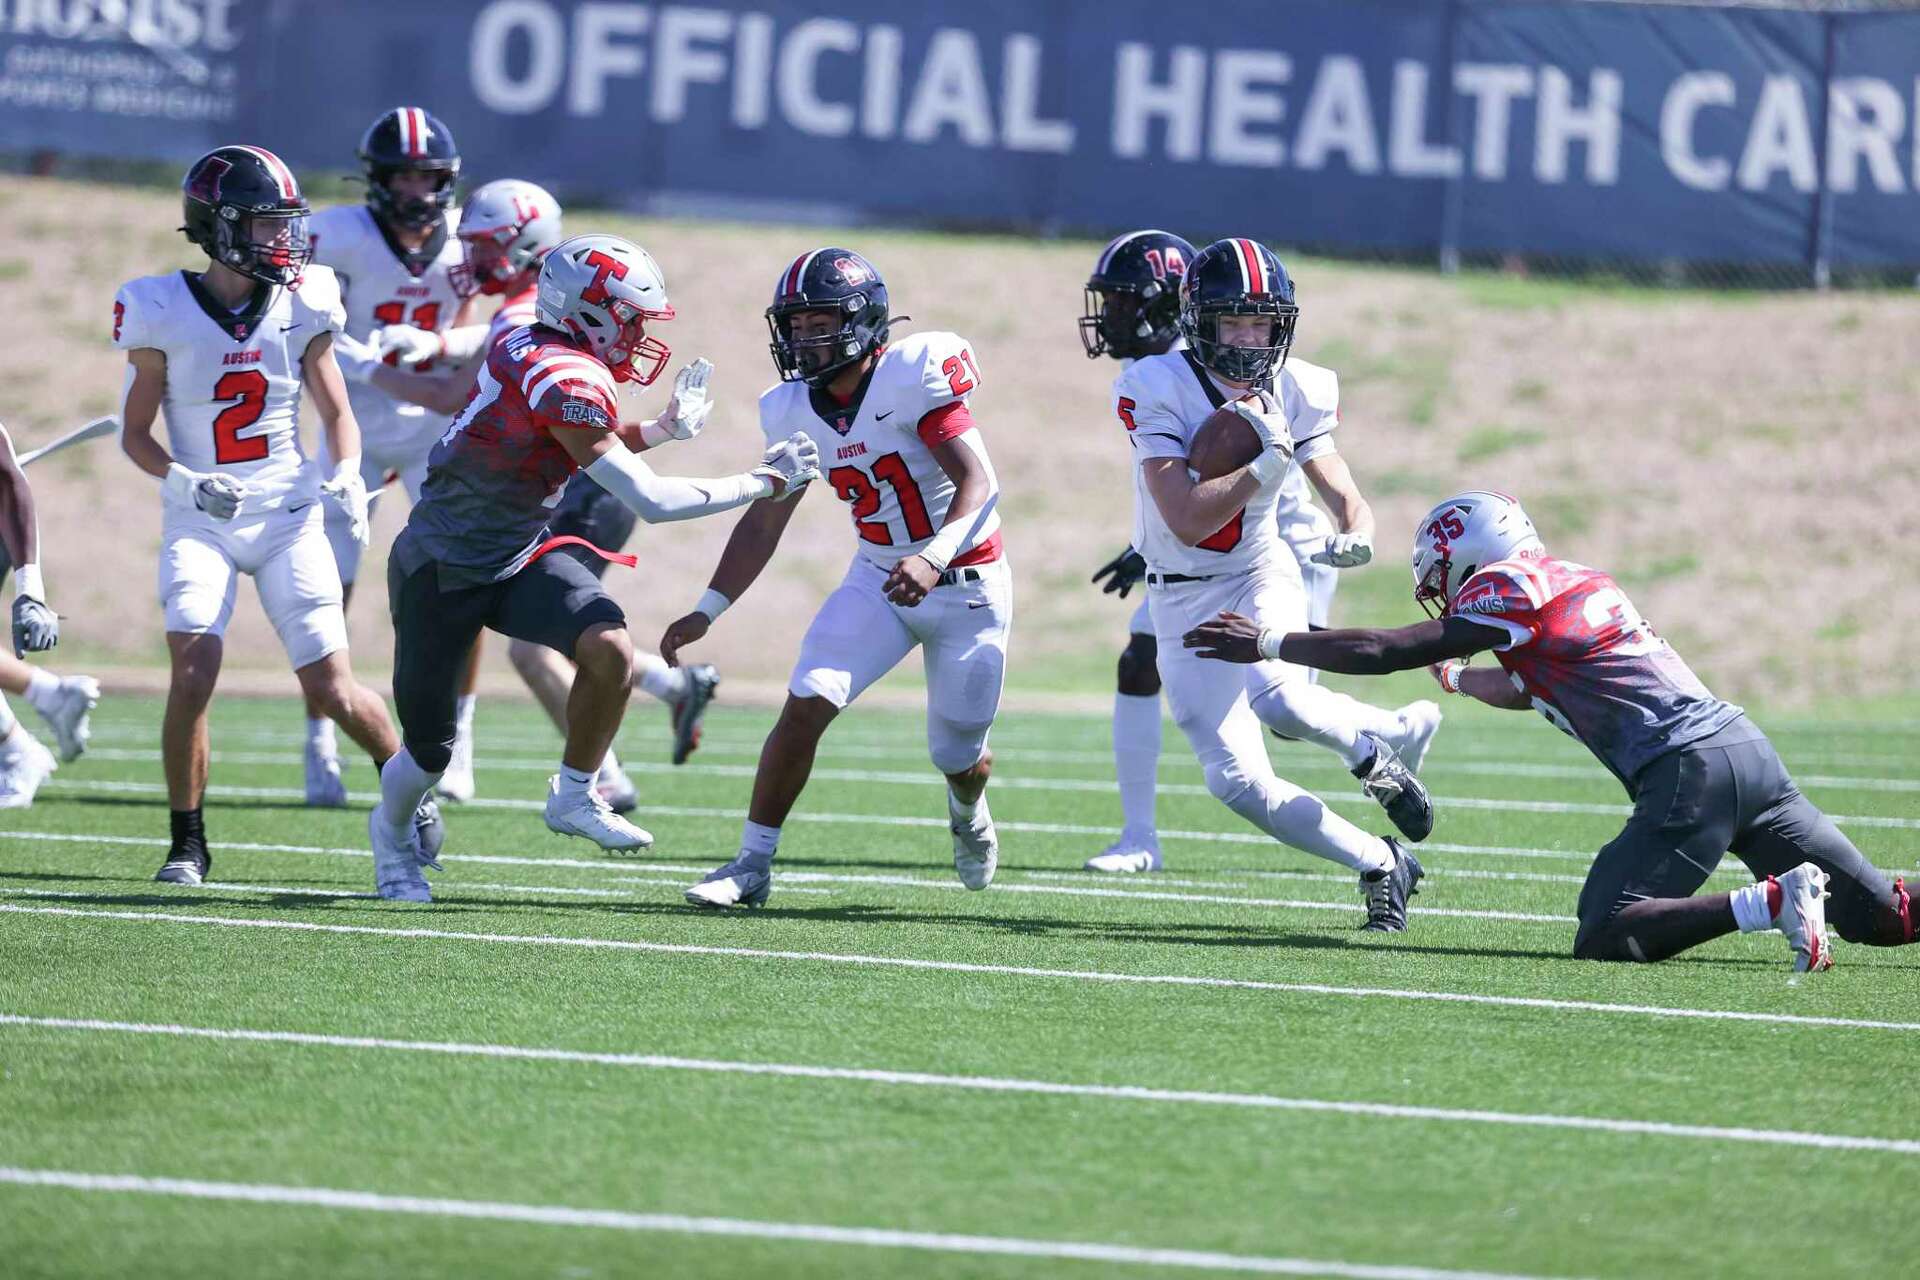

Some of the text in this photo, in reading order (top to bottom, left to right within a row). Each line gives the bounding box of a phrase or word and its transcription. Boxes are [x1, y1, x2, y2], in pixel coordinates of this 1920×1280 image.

[468, 0, 1920, 194] OFFICIAL HEALTH CAR
[580, 250, 629, 306] T
[1145, 247, 1186, 280] 14
[222, 350, 262, 365] AUSTIN
[942, 349, 981, 397] 21
[213, 369, 269, 465] 2
[837, 441, 868, 460] AUSTIN
[828, 451, 937, 546] 21
[1427, 508, 1465, 553] 35
